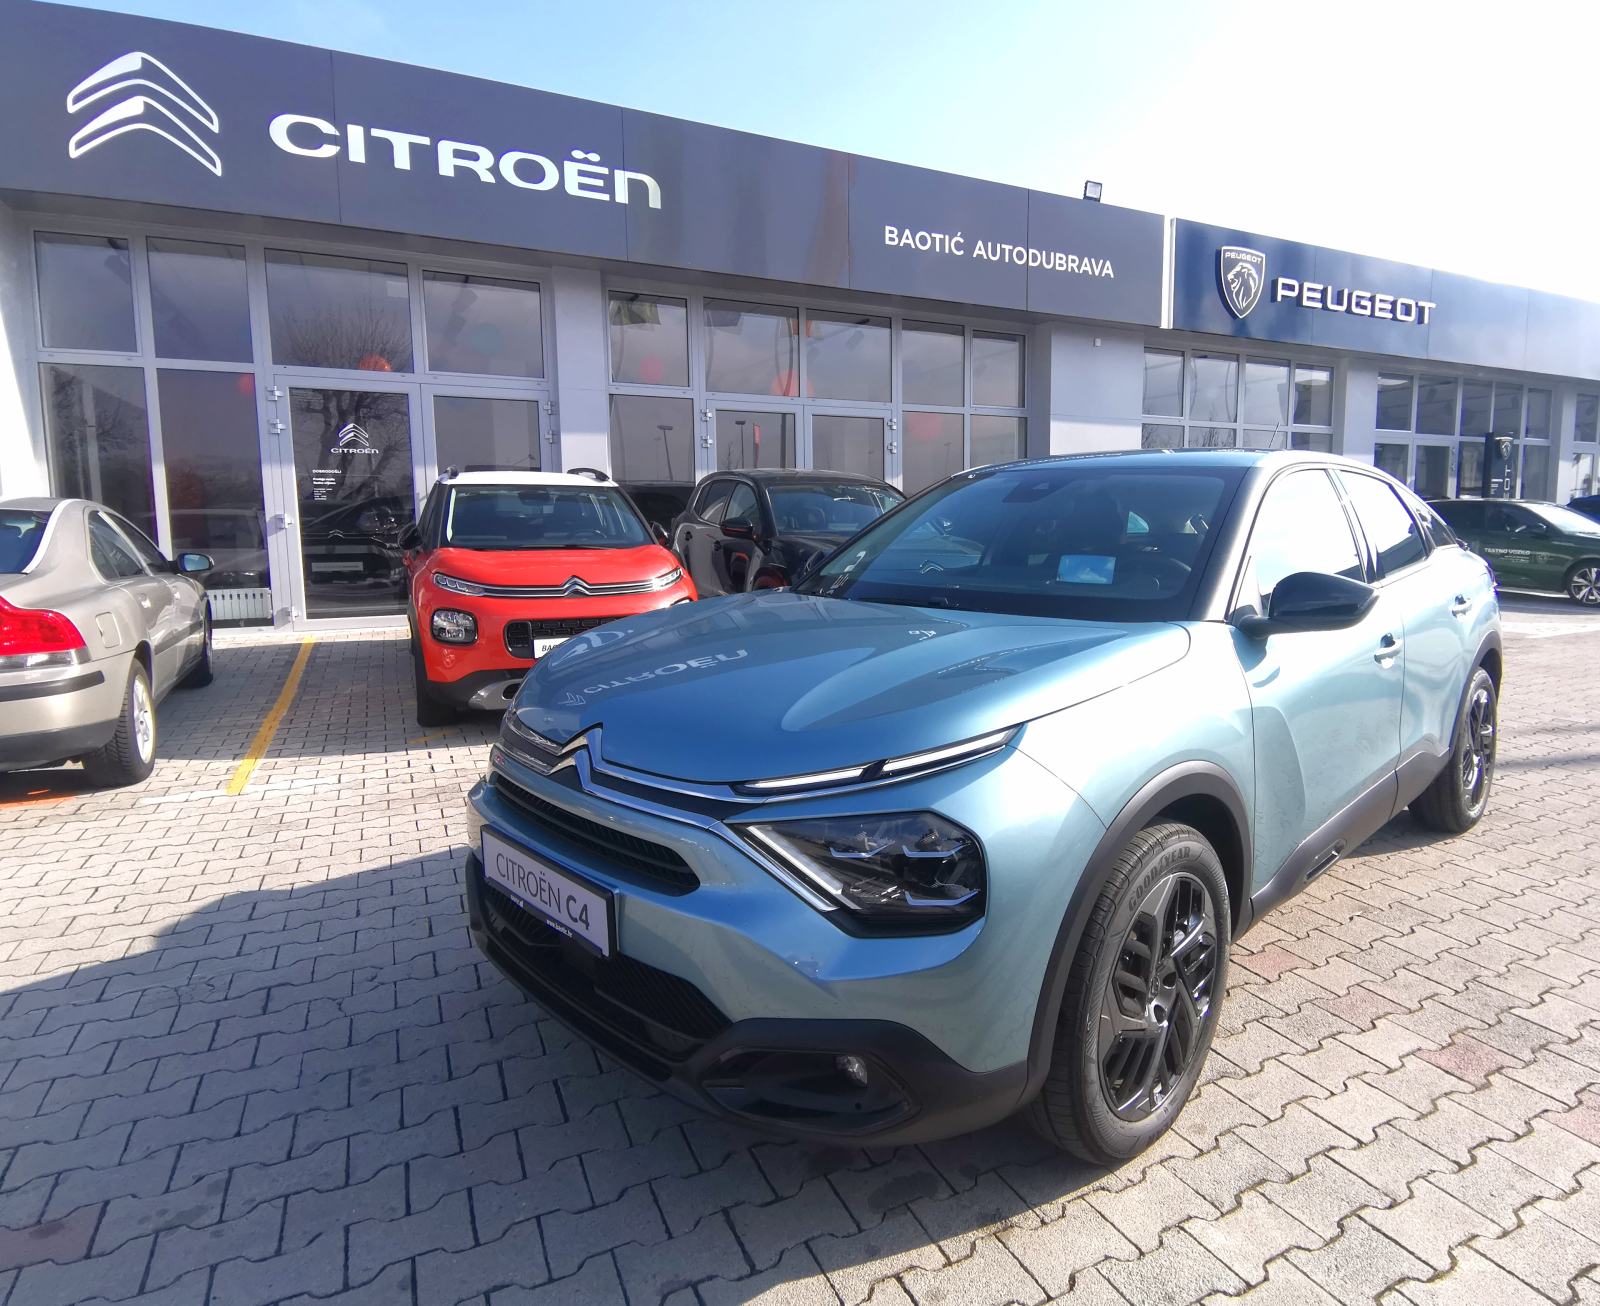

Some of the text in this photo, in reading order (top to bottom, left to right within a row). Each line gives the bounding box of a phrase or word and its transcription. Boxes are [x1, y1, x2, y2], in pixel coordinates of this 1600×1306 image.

[268, 113, 662, 210] CITROËN
[884, 225, 1115, 279] BAOTIĆ AUTODUBRAVA
[1224, 251, 1263, 264] PEUGEOT
[1275, 277, 1437, 325] PEUGEOT
[495, 852, 590, 931] CITROËN C4
